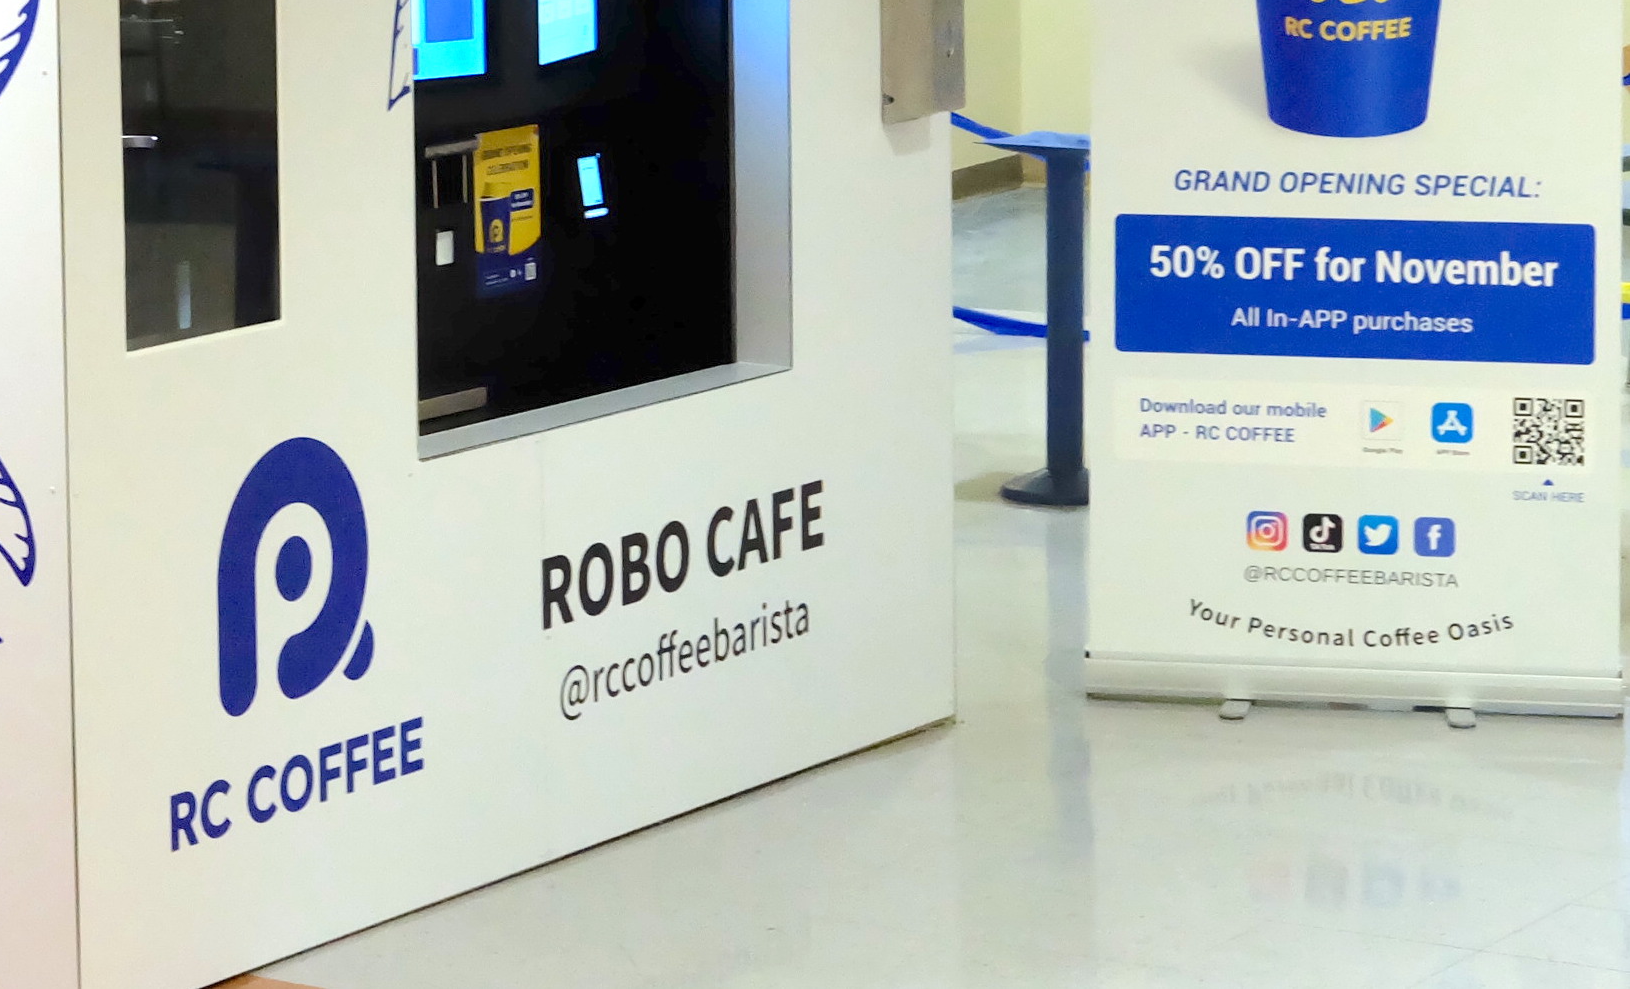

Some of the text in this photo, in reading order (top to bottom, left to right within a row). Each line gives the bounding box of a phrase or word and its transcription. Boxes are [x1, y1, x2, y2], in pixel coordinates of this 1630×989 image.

[1284, 16, 1412, 41] RC COFFEE
[1174, 169, 1542, 199] GRAND OPENING SPECIAL:
[1150, 245, 1559, 287] 50% OFF for November
[1231, 307, 1474, 334] All In-APP purchases
[1140, 398, 1327, 419] Download our mobile
[1140, 424, 1176, 441] APP
[1195, 425, 1220, 441] RC
[1226, 426, 1295, 443] COFFEE
[1512, 490, 1584, 503] SCAN HERE
[541, 479, 825, 629] ROBO CAFE
[1243, 565, 1459, 588] @RCCOFFEEBARISTA
[1189, 599, 1515, 648] Your Personal Coffee Oasis
[559, 599, 811, 721] @rccoffeebarista
[170, 717, 425, 852] RC COFFEE
